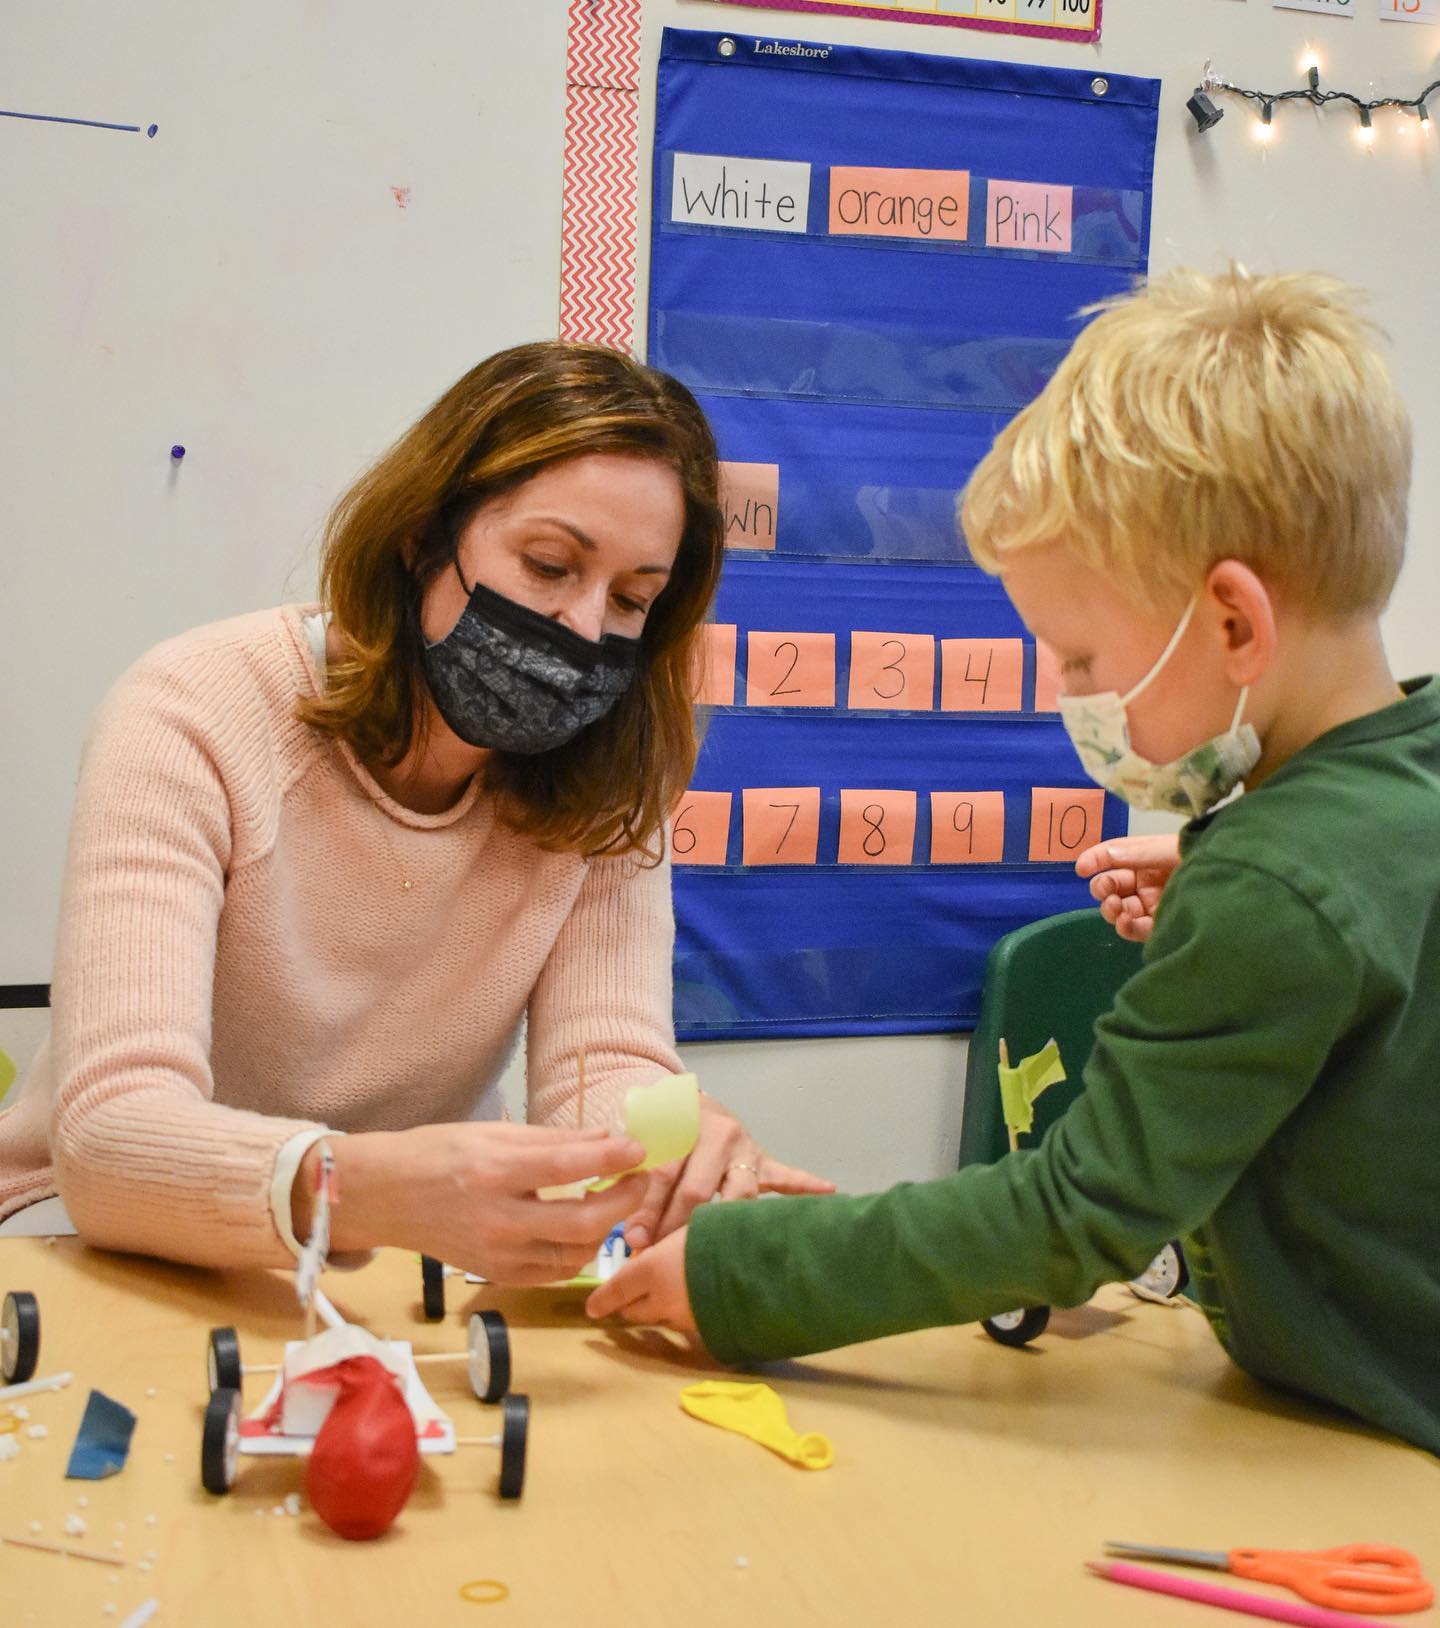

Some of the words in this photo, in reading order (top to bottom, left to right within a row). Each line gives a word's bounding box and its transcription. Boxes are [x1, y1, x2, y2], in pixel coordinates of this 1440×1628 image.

[754, 39, 830, 59] Lakeshore
[682, 166, 795, 223] White
[725, 499, 772, 535] wn
[770, 642, 801, 696] 2
[873, 641, 906, 698] 3
[965, 648, 993, 704] 4
[672, 804, 696, 854] 6
[769, 804, 800, 854] 7
[863, 804, 886, 856] 8
[953, 802, 974, 854] 9
[1048, 802, 1087, 854] 10
